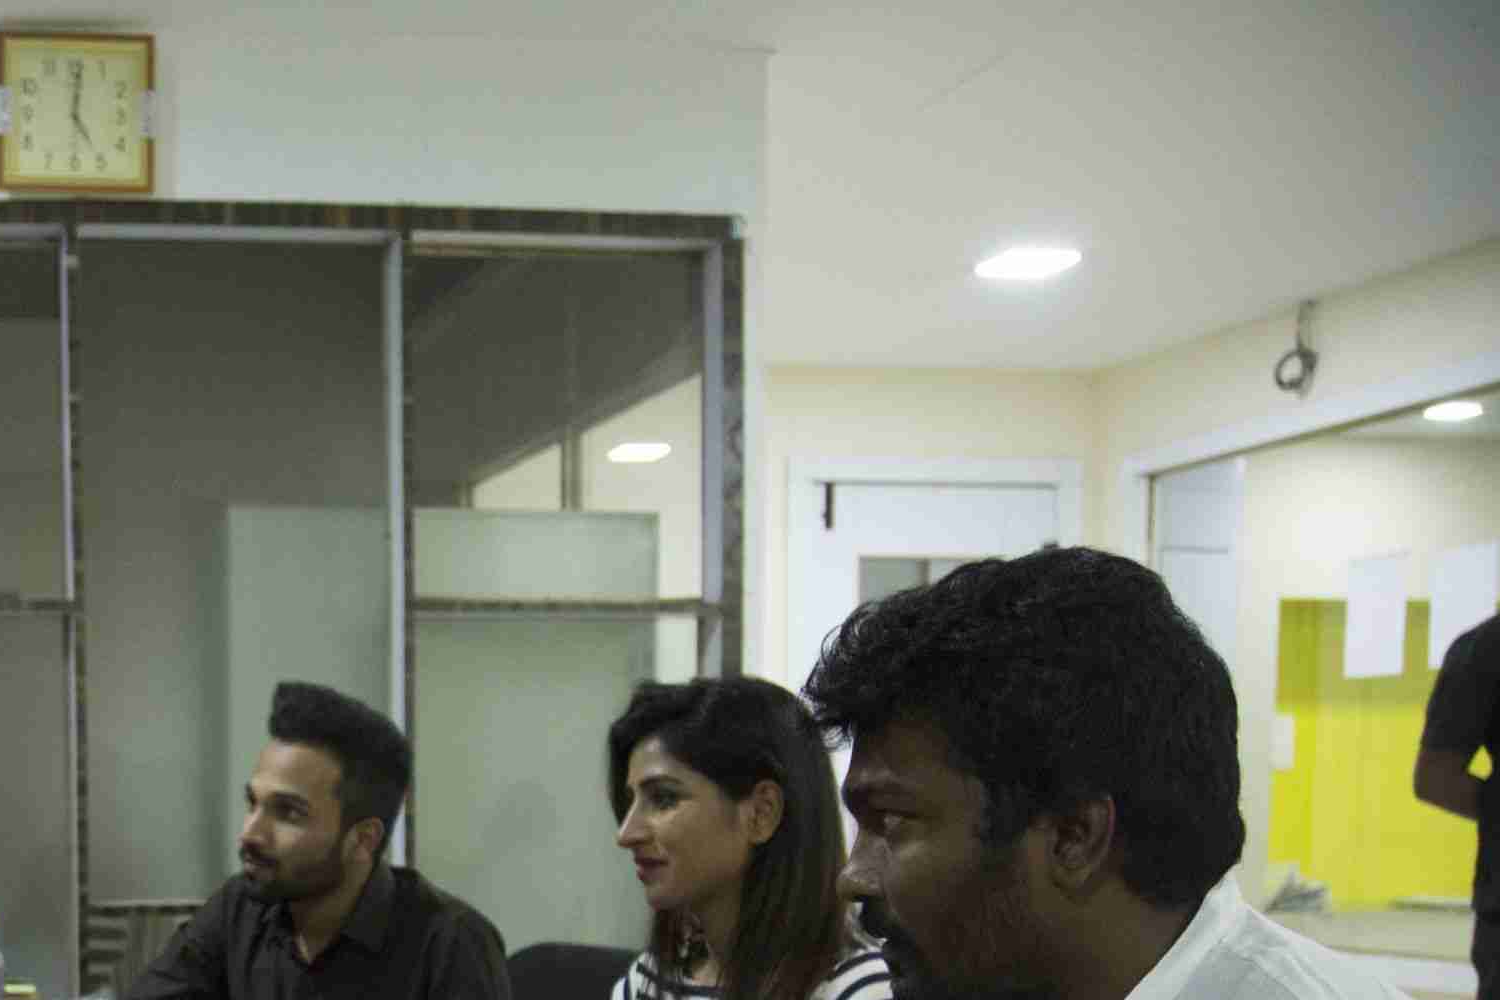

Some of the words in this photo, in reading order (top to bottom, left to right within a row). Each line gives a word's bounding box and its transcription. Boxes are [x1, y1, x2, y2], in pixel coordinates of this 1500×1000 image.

[21, 78, 38, 96] 10
[114, 80, 127, 99] 2
[115, 107, 127, 126] 3
[114, 136, 126, 152] 4
[95, 154, 108, 171] 5
